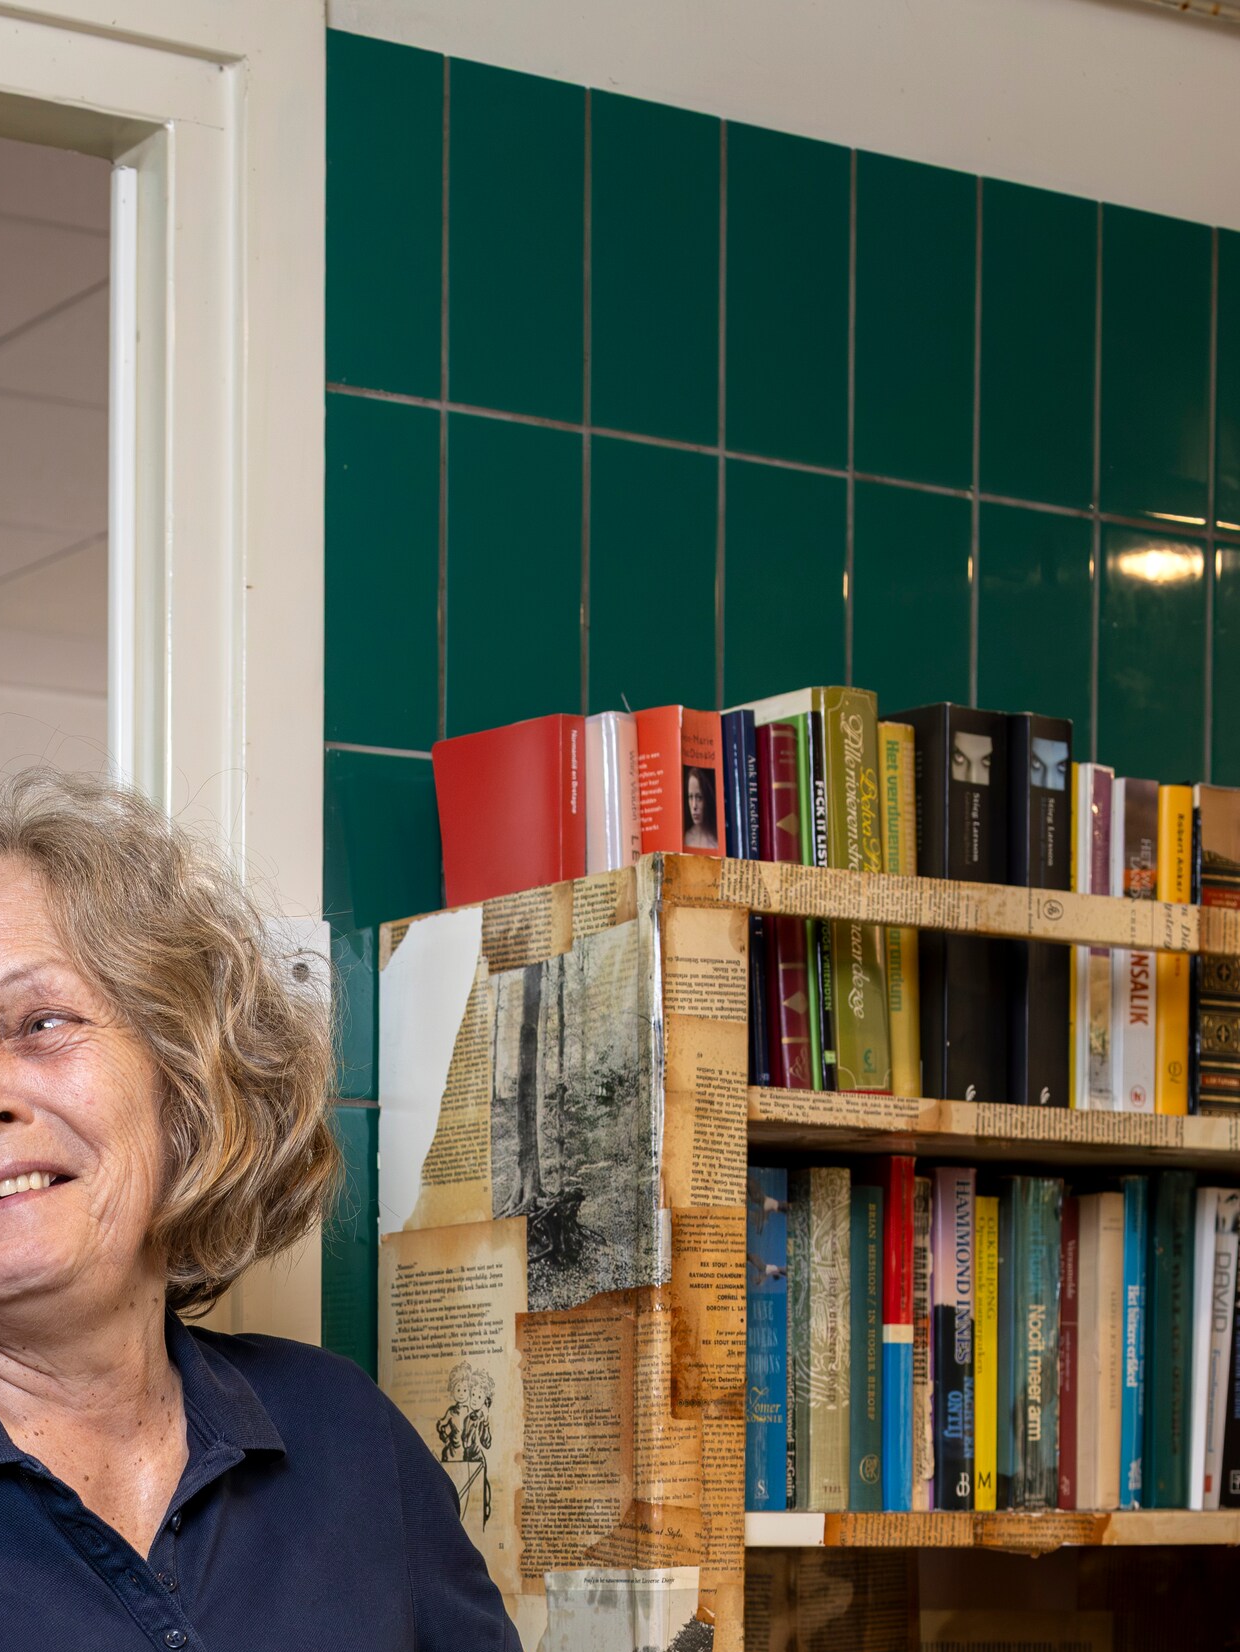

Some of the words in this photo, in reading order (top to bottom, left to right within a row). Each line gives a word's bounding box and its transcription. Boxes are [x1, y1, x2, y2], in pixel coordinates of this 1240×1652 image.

[1130, 950, 1150, 1026] NSALIK
[955, 1180, 971, 1295] HAMMOND
[954, 1299, 972, 1365] INNES
[1027, 1303, 1046, 1351] Nooit
[1027, 1355, 1042, 1404] meer
